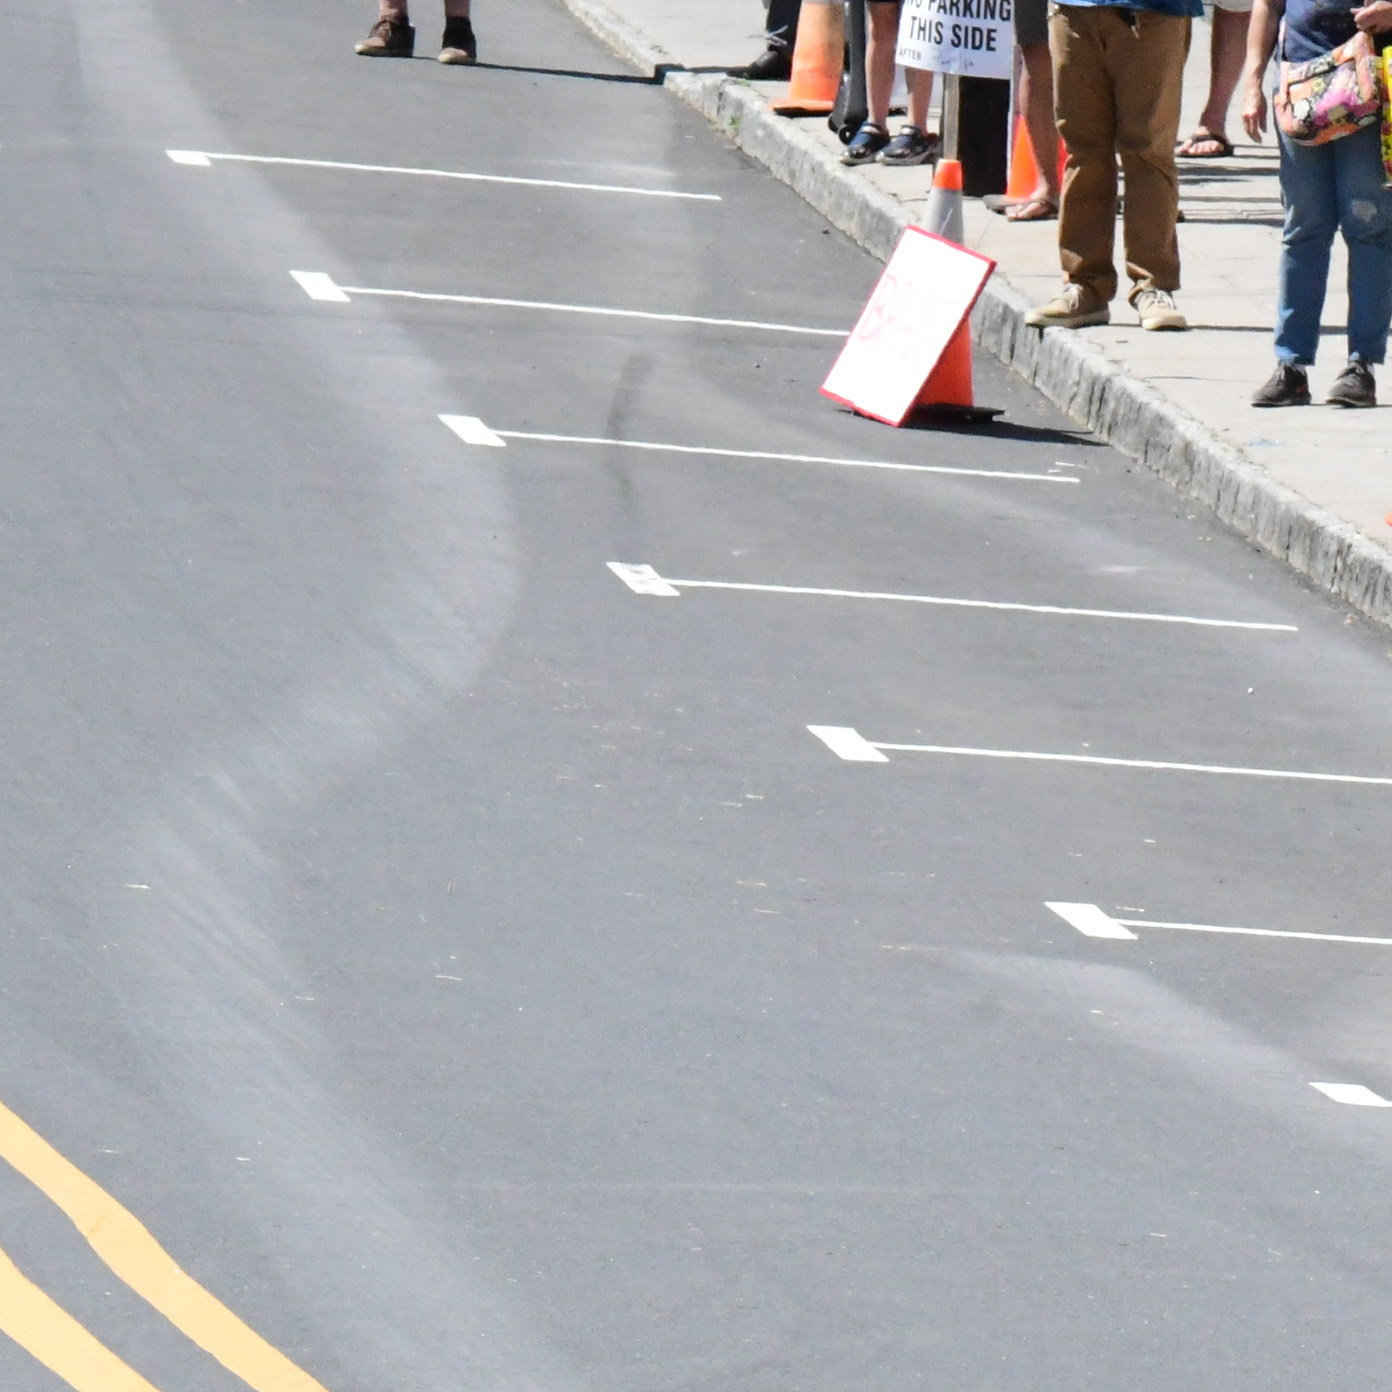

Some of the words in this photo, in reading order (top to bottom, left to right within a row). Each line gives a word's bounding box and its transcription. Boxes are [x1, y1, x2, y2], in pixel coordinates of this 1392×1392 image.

[909, 15, 944, 45] THIS
[950, 23, 997, 52] SIDE
[898, 47, 922, 61] AFTER
